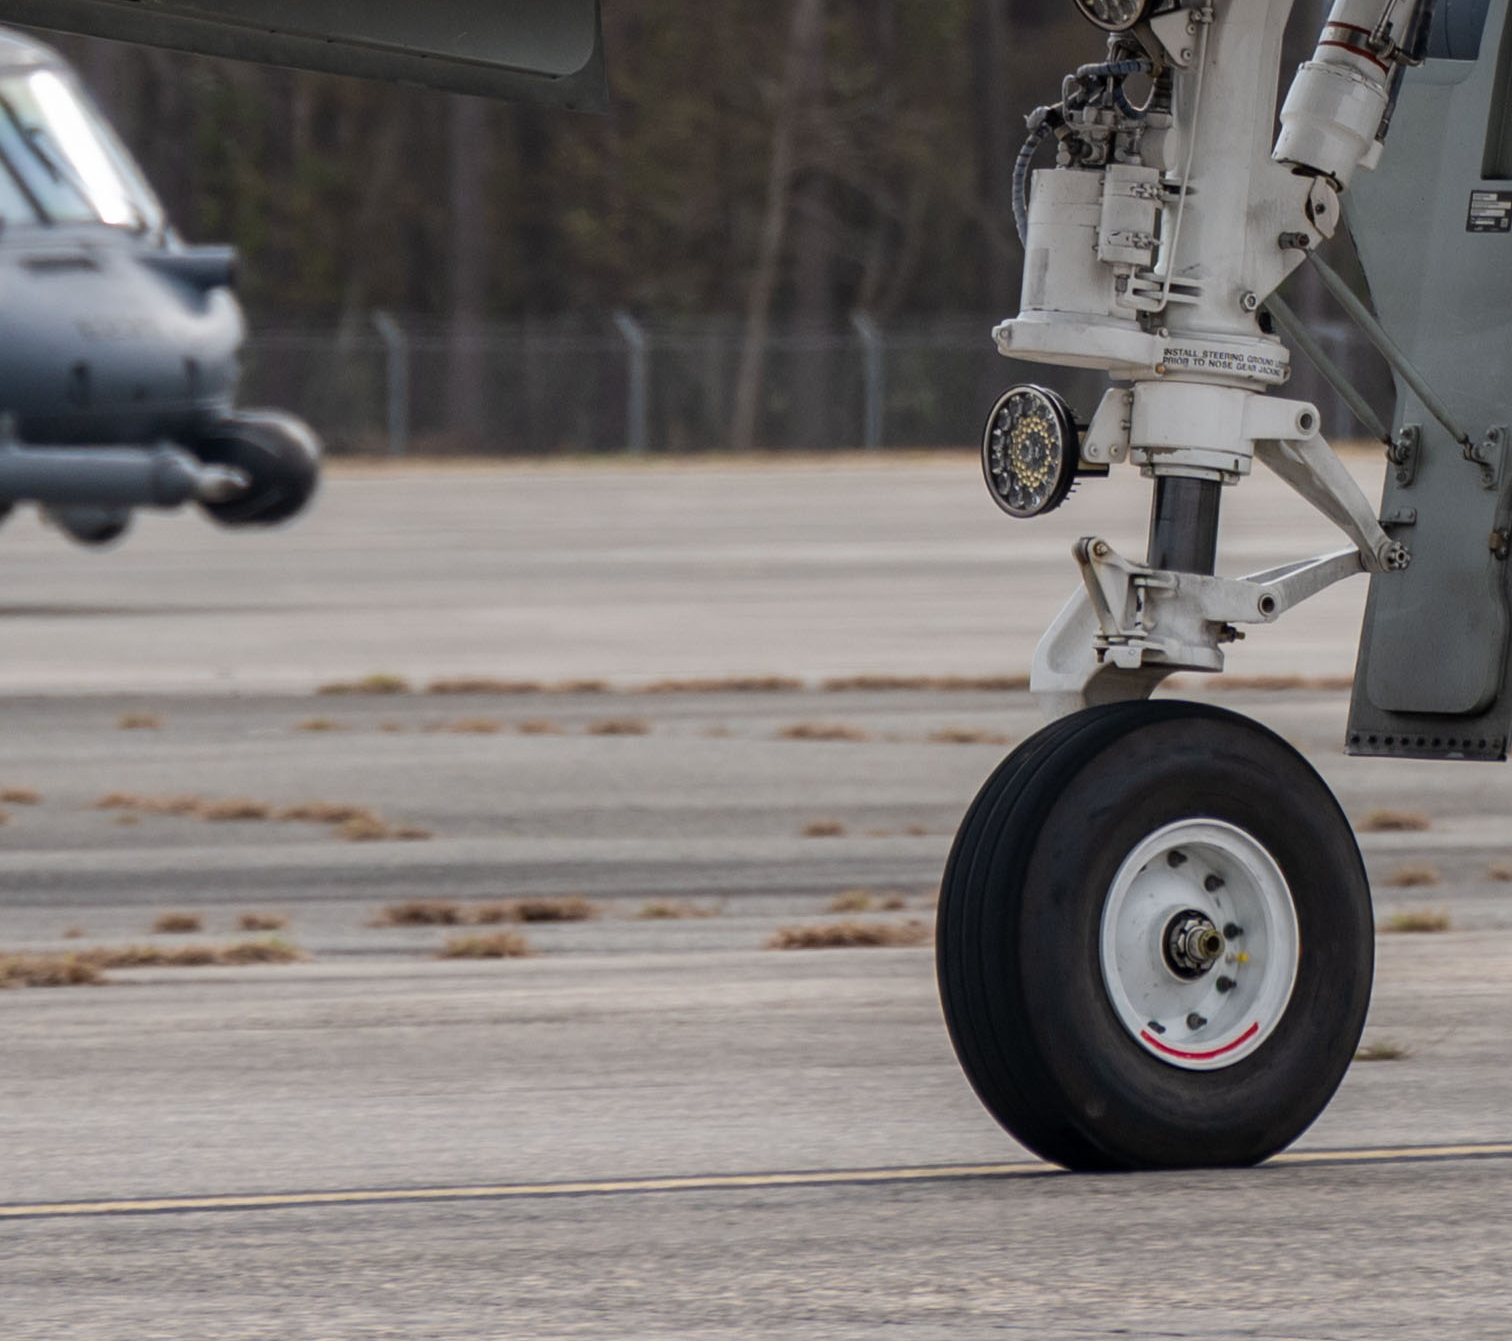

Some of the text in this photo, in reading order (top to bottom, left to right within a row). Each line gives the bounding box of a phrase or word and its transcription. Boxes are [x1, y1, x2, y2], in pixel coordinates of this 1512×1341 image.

[1163, 348, 1198, 357] INSTALL
[1202, 350, 1244, 362] STEERING
[1163, 357, 1189, 367] PRIOR
[1193, 358, 1205, 366] TO
[1209, 360, 1233, 369] NOSE
